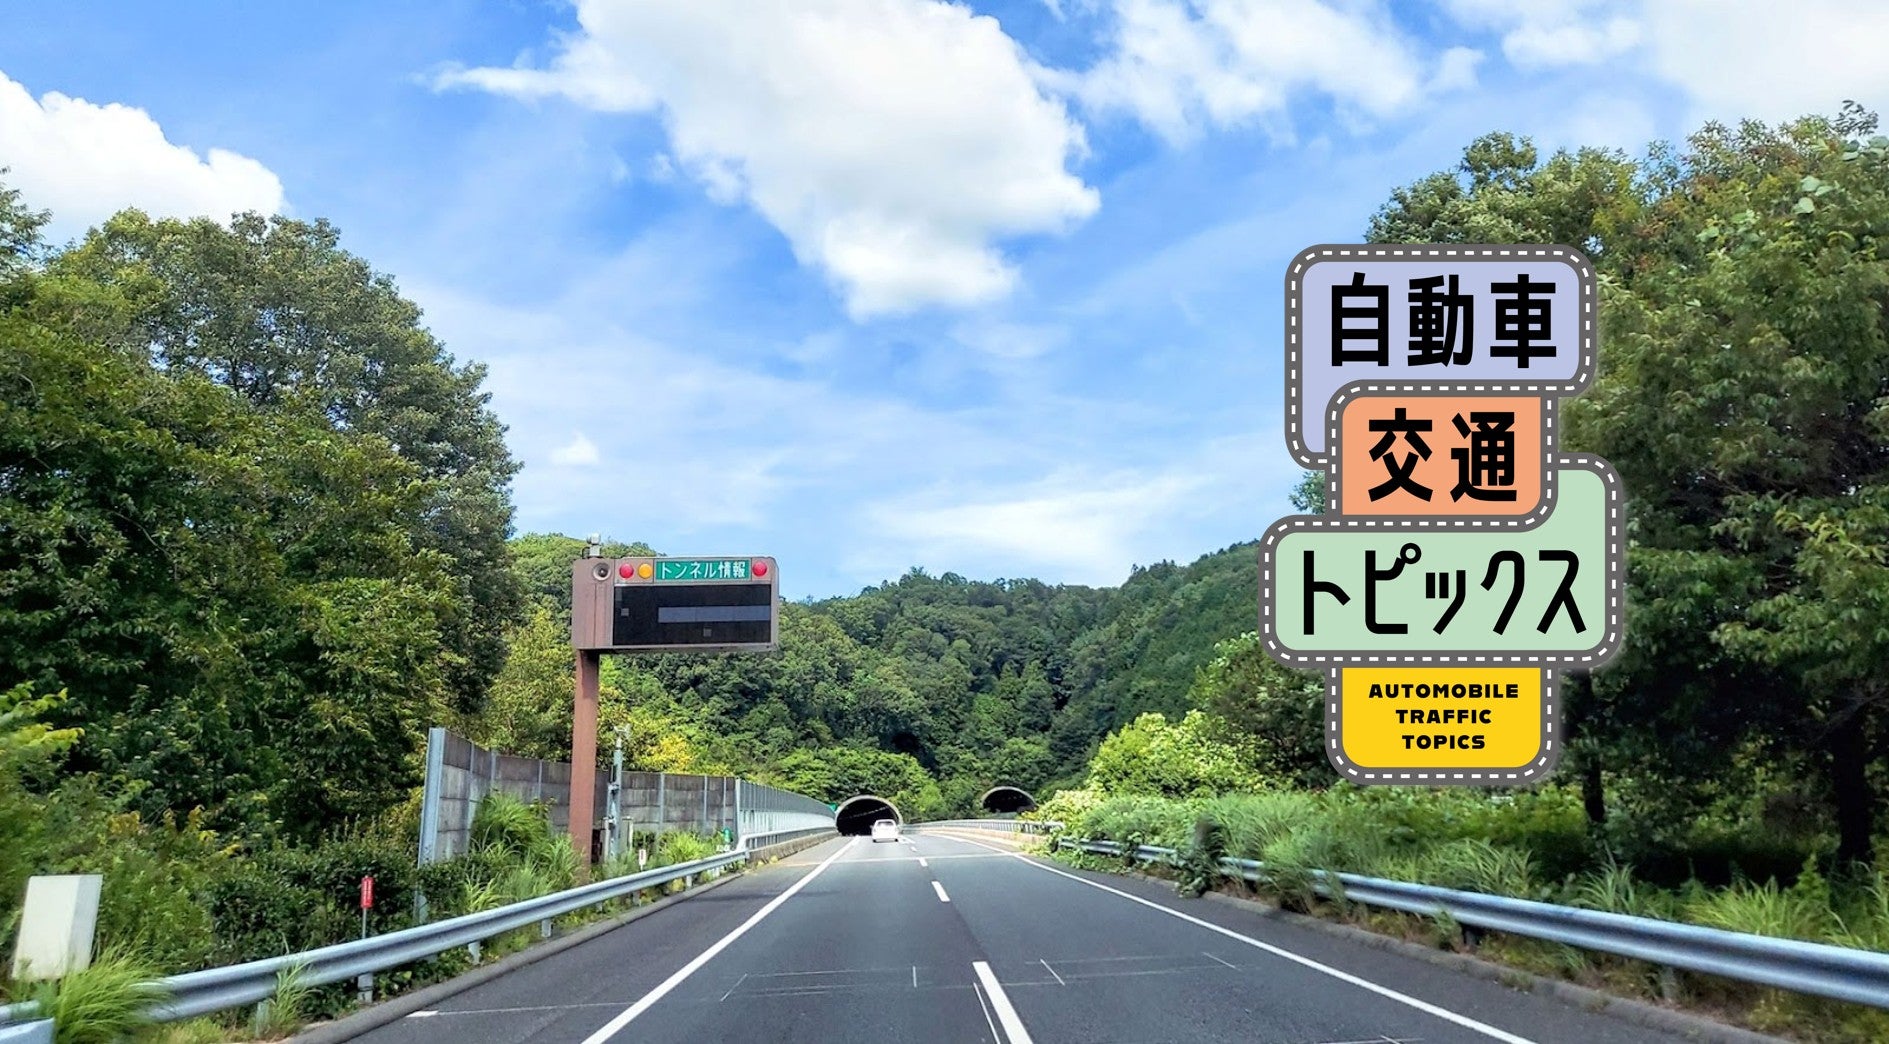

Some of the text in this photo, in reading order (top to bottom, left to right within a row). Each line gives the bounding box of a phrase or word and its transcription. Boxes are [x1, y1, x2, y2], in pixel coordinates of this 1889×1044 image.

[661, 561, 746, 580] トンネル情報
